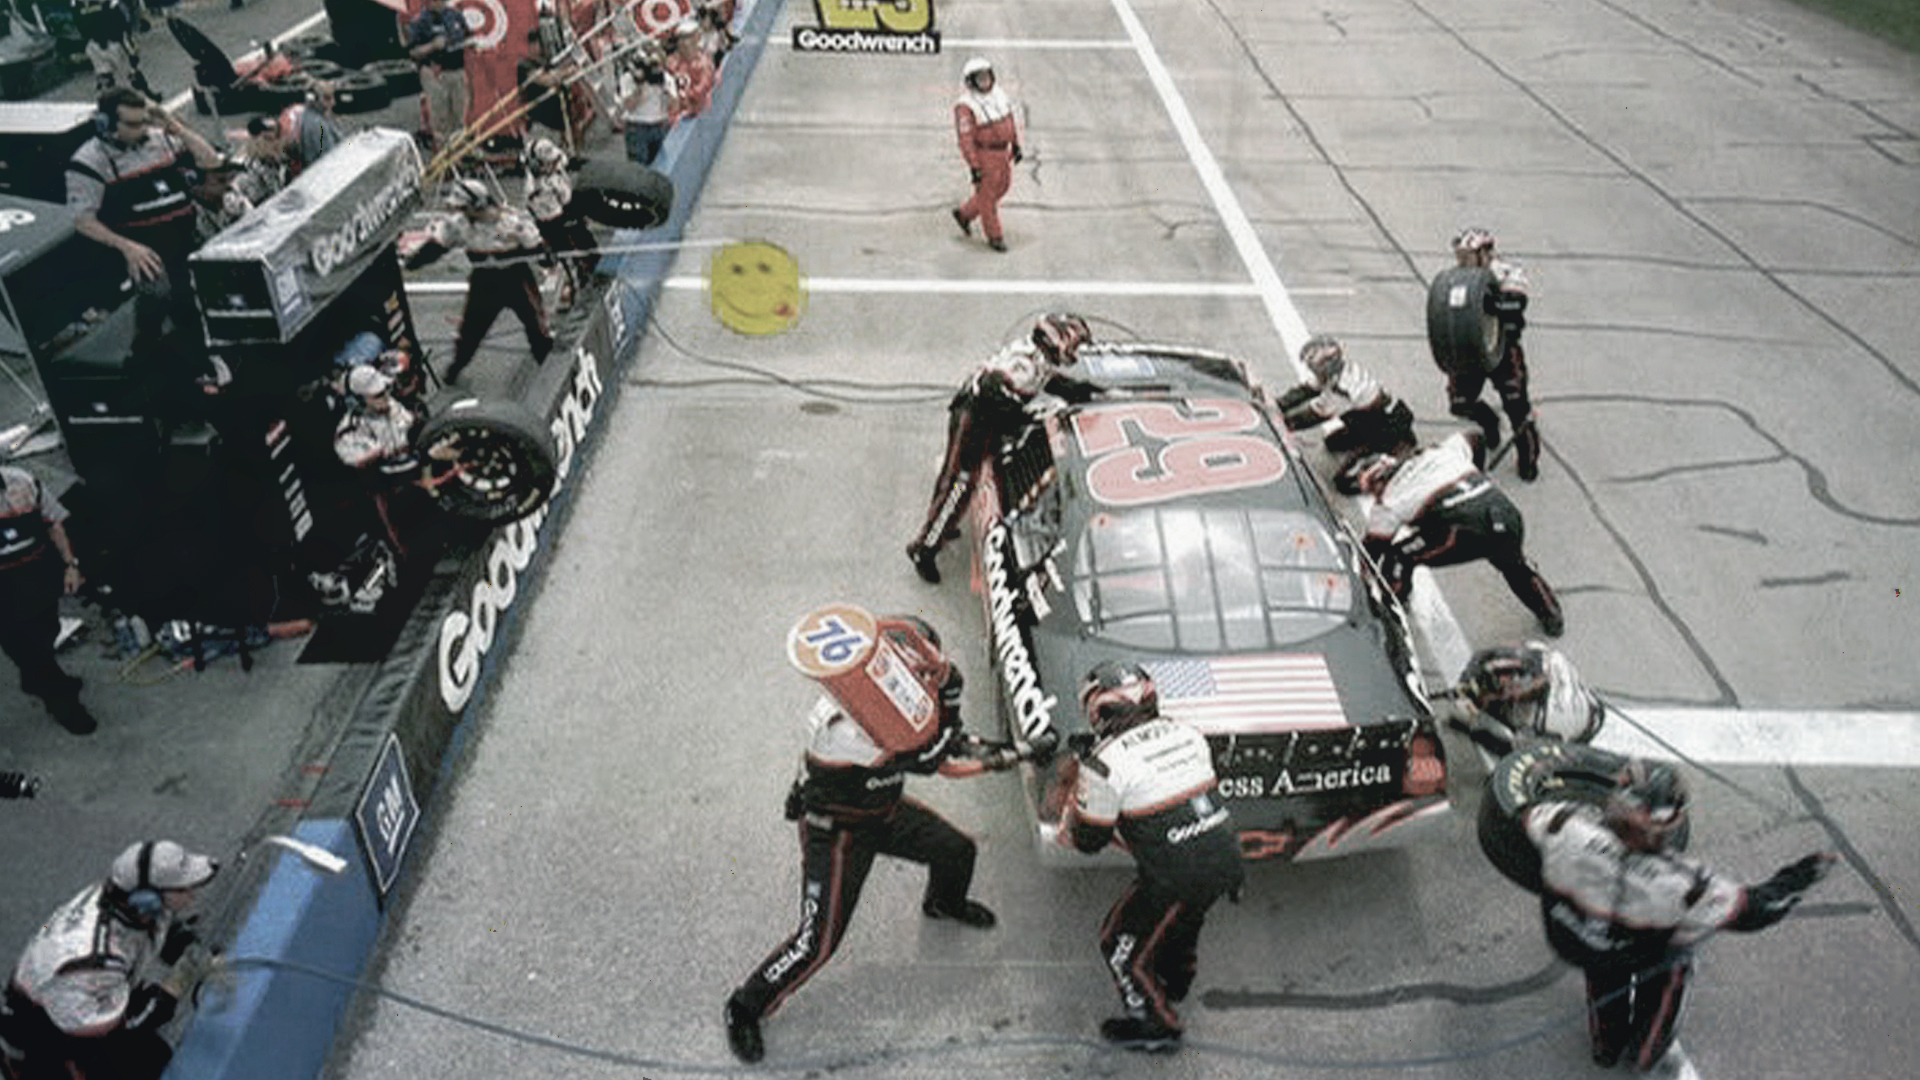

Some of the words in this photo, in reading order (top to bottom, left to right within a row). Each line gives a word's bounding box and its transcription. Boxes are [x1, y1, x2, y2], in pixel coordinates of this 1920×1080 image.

[798, 30, 935, 52] Goodwrench
[1070, 398, 1288, 506] 29
[806, 617, 863, 661] 76
[984, 524, 1058, 741] Goodwrench
[376, 774, 406, 842] GM
